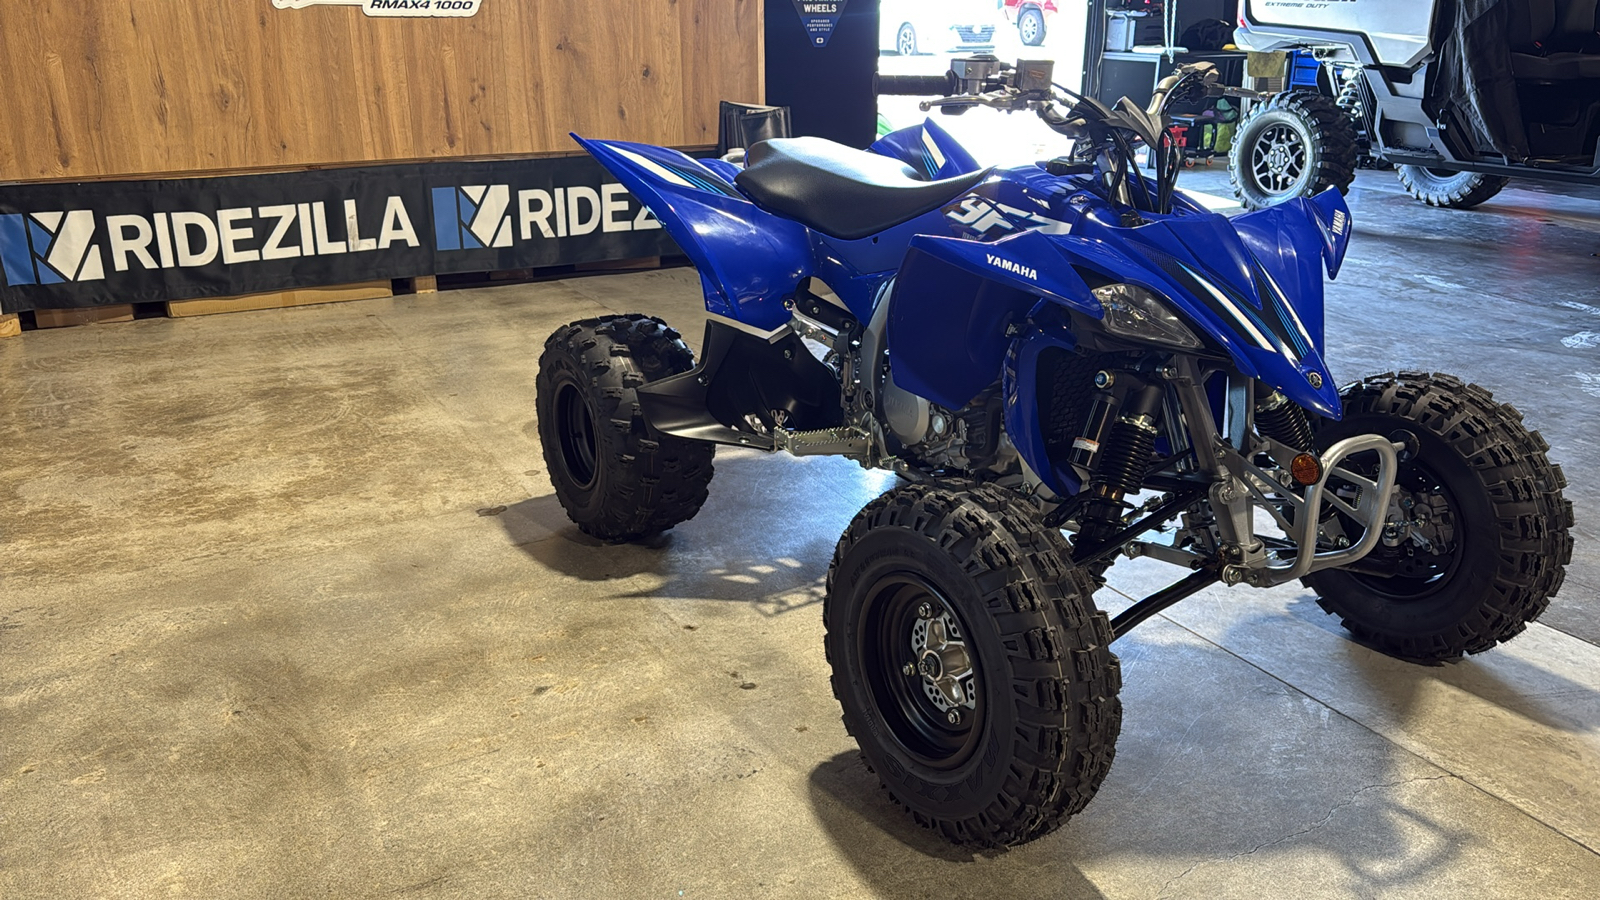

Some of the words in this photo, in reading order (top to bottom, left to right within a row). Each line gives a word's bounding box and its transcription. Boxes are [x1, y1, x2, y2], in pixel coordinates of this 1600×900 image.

[370, 0, 430, 9] RMAX4
[434, 1, 474, 9] 1000
[803, 4, 837, 13] WHEELS
[106, 195, 420, 272] RIDEZILLA
[1332, 209, 1345, 236] YAMAHA
[986, 253, 1038, 280] YAMAHA
[883, 722, 1000, 803] MAXXIS
